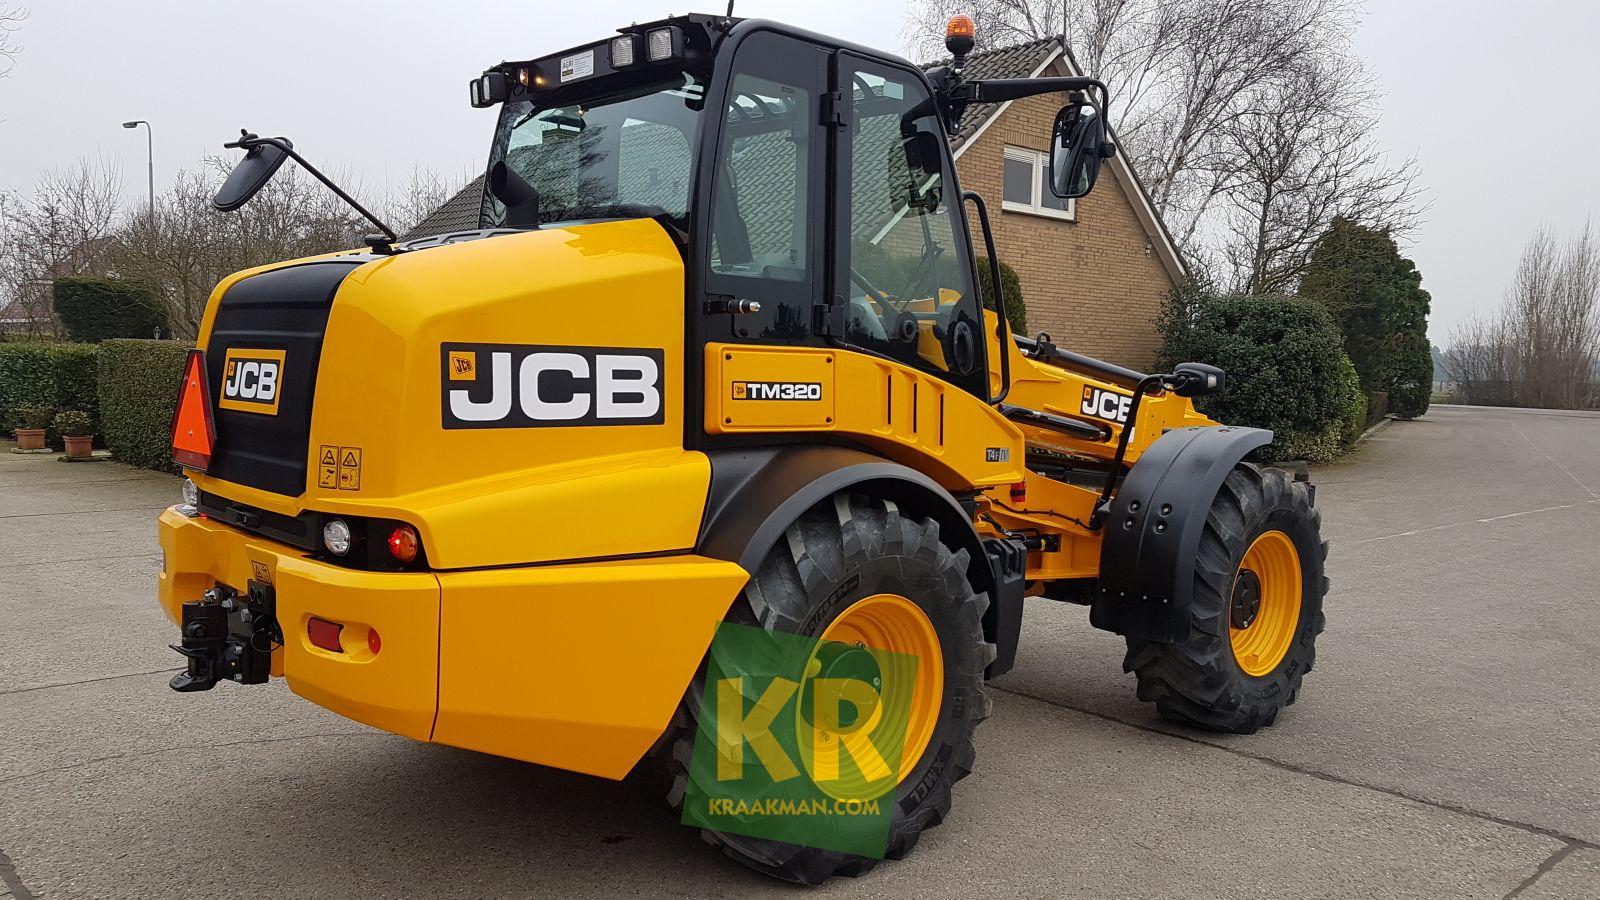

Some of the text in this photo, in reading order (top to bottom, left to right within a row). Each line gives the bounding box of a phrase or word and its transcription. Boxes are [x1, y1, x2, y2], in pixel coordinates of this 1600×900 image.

[226, 361, 278, 400] JCB
[450, 352, 660, 421] JCB
[747, 383, 820, 399] TM320
